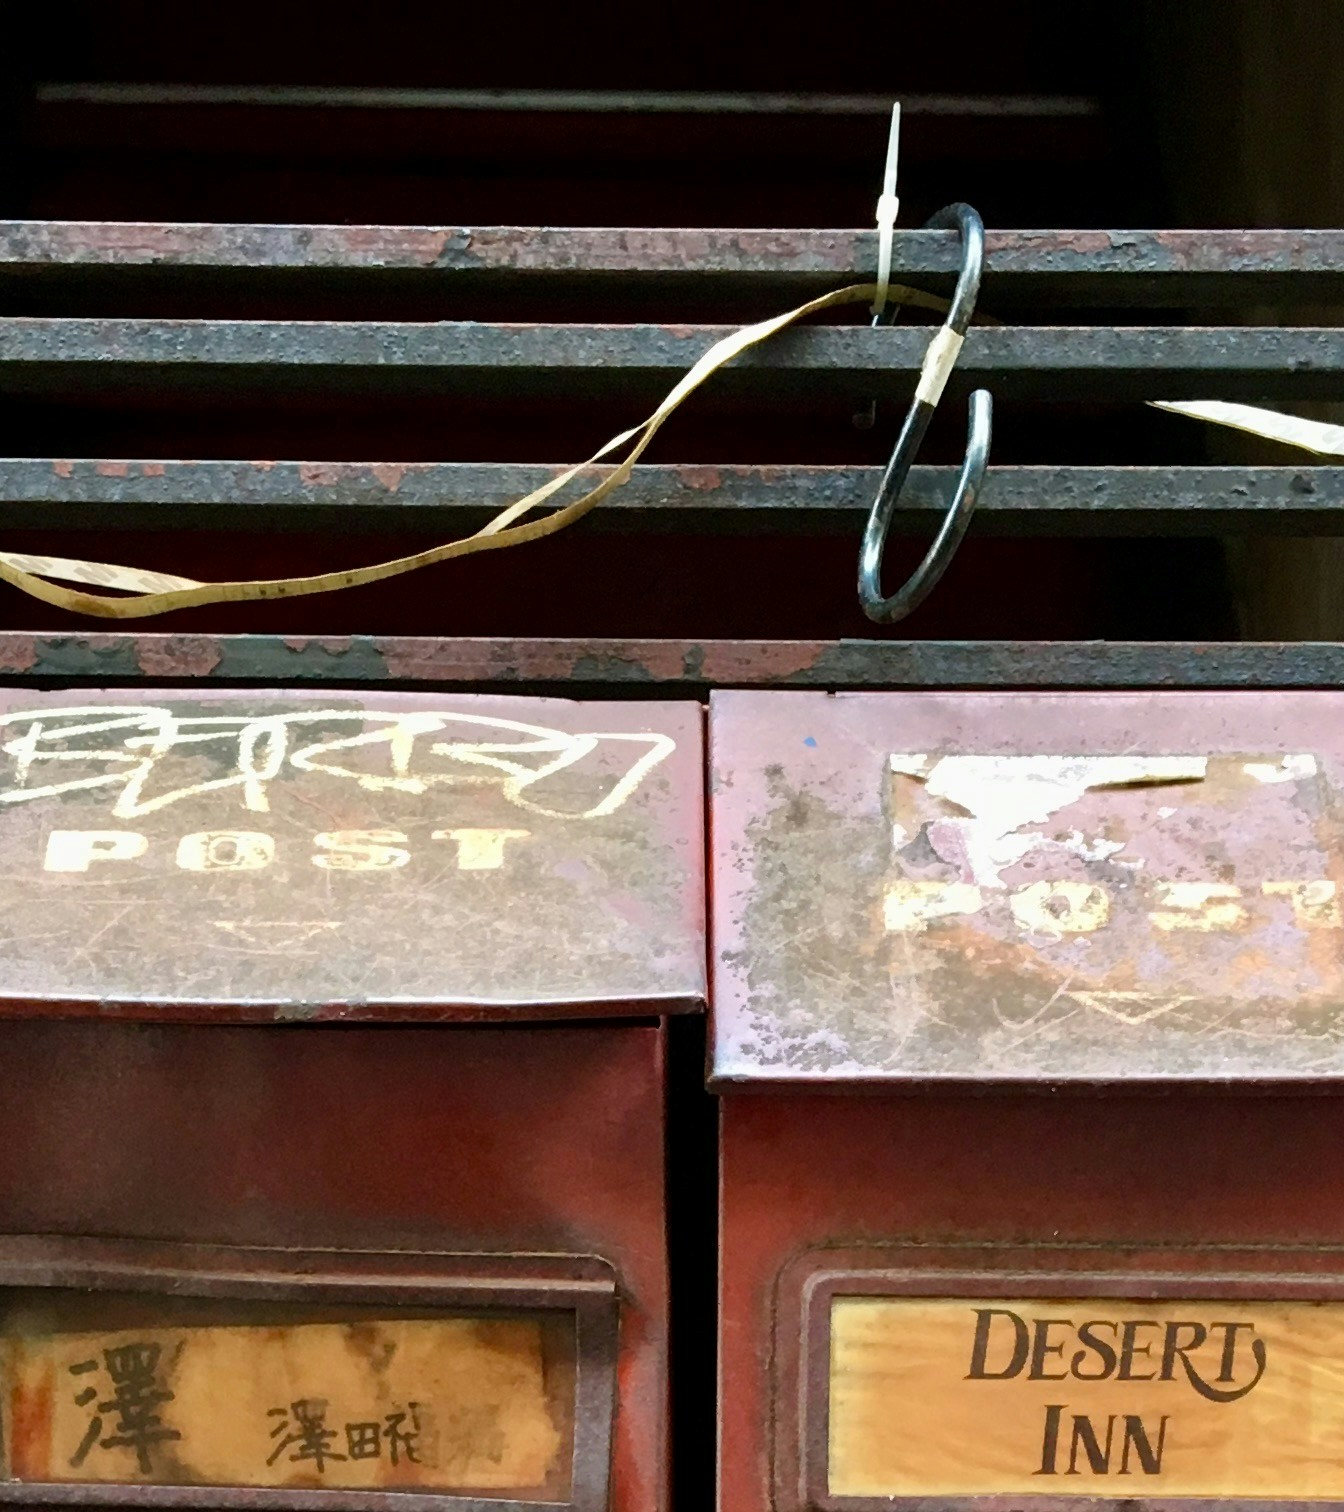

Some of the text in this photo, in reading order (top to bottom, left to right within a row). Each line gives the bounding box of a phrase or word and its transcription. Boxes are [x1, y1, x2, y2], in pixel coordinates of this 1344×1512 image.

[42, 828, 532, 873] POST
[963, 1308, 1267, 1403] DESERT
[1032, 1404, 1171, 1476] INN
